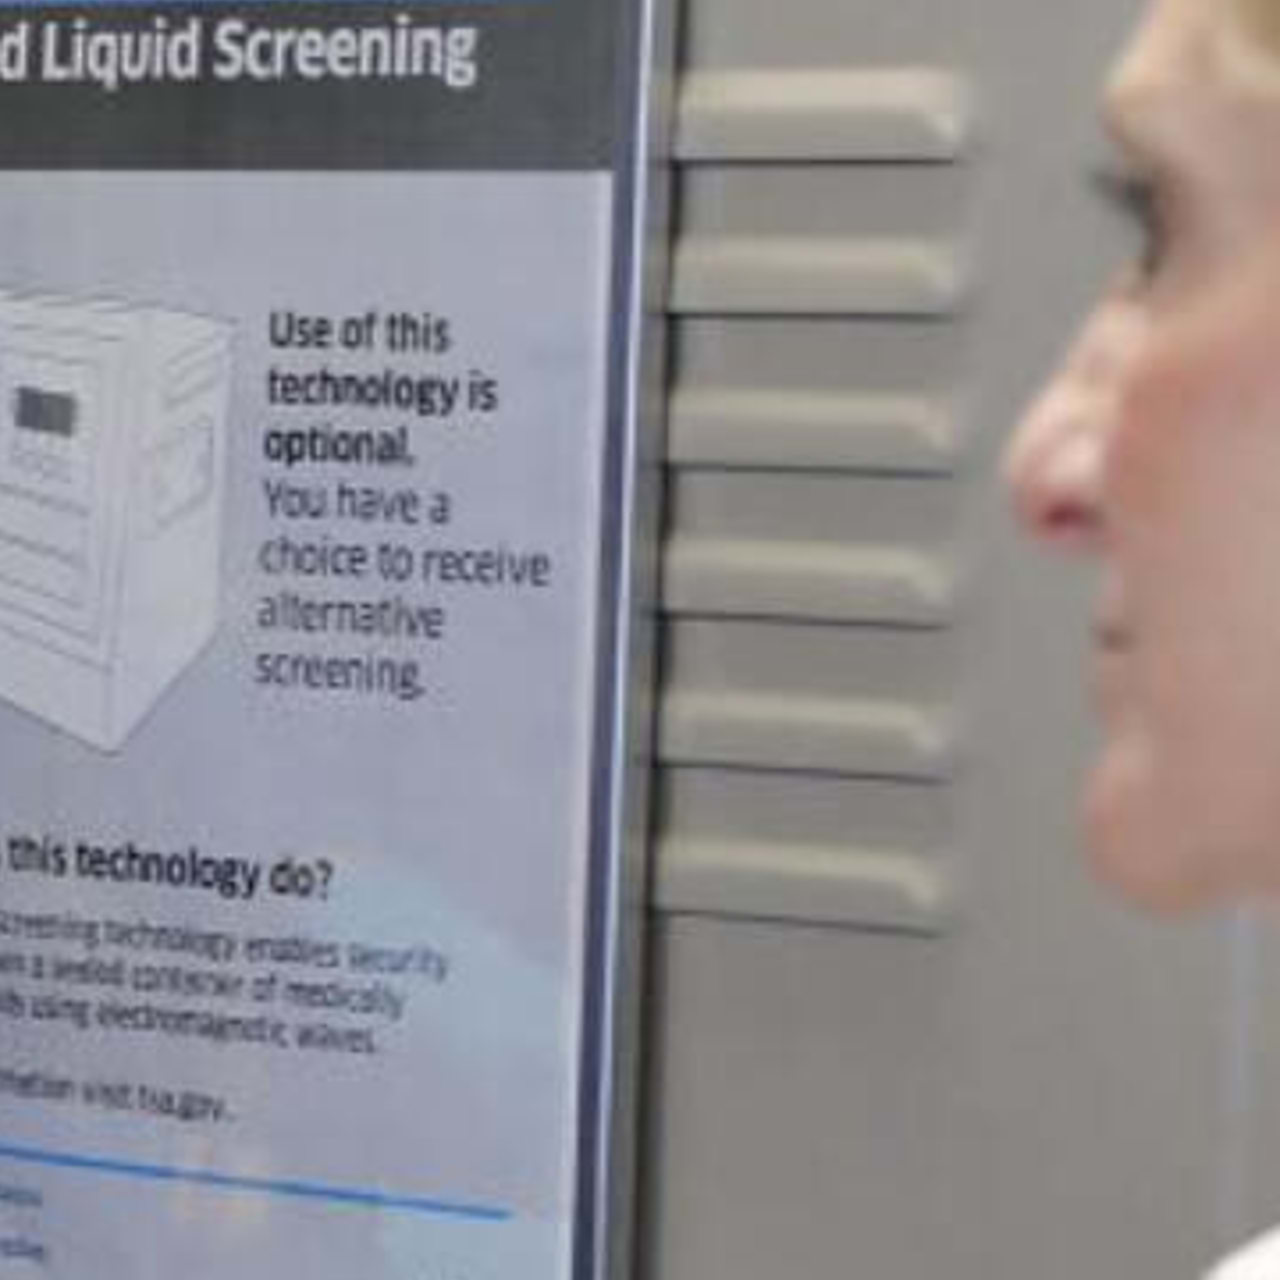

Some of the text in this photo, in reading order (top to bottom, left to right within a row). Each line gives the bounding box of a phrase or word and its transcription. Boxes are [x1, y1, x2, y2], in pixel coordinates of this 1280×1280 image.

[42, 17, 199, 90] Liquid
[213, 14, 480, 88] Screening
[268, 311, 452, 354] Use of this
[268, 369, 498, 417] technology is
[263, 425, 416, 468] optional.
[264, 480, 452, 524] You have a
[258, 535, 551, 588] choice to receive
[256, 592, 445, 640] alternative
[7, 831, 67, 878] this
[75, 839, 262, 901] technology
[268, 856, 334, 901] do?
